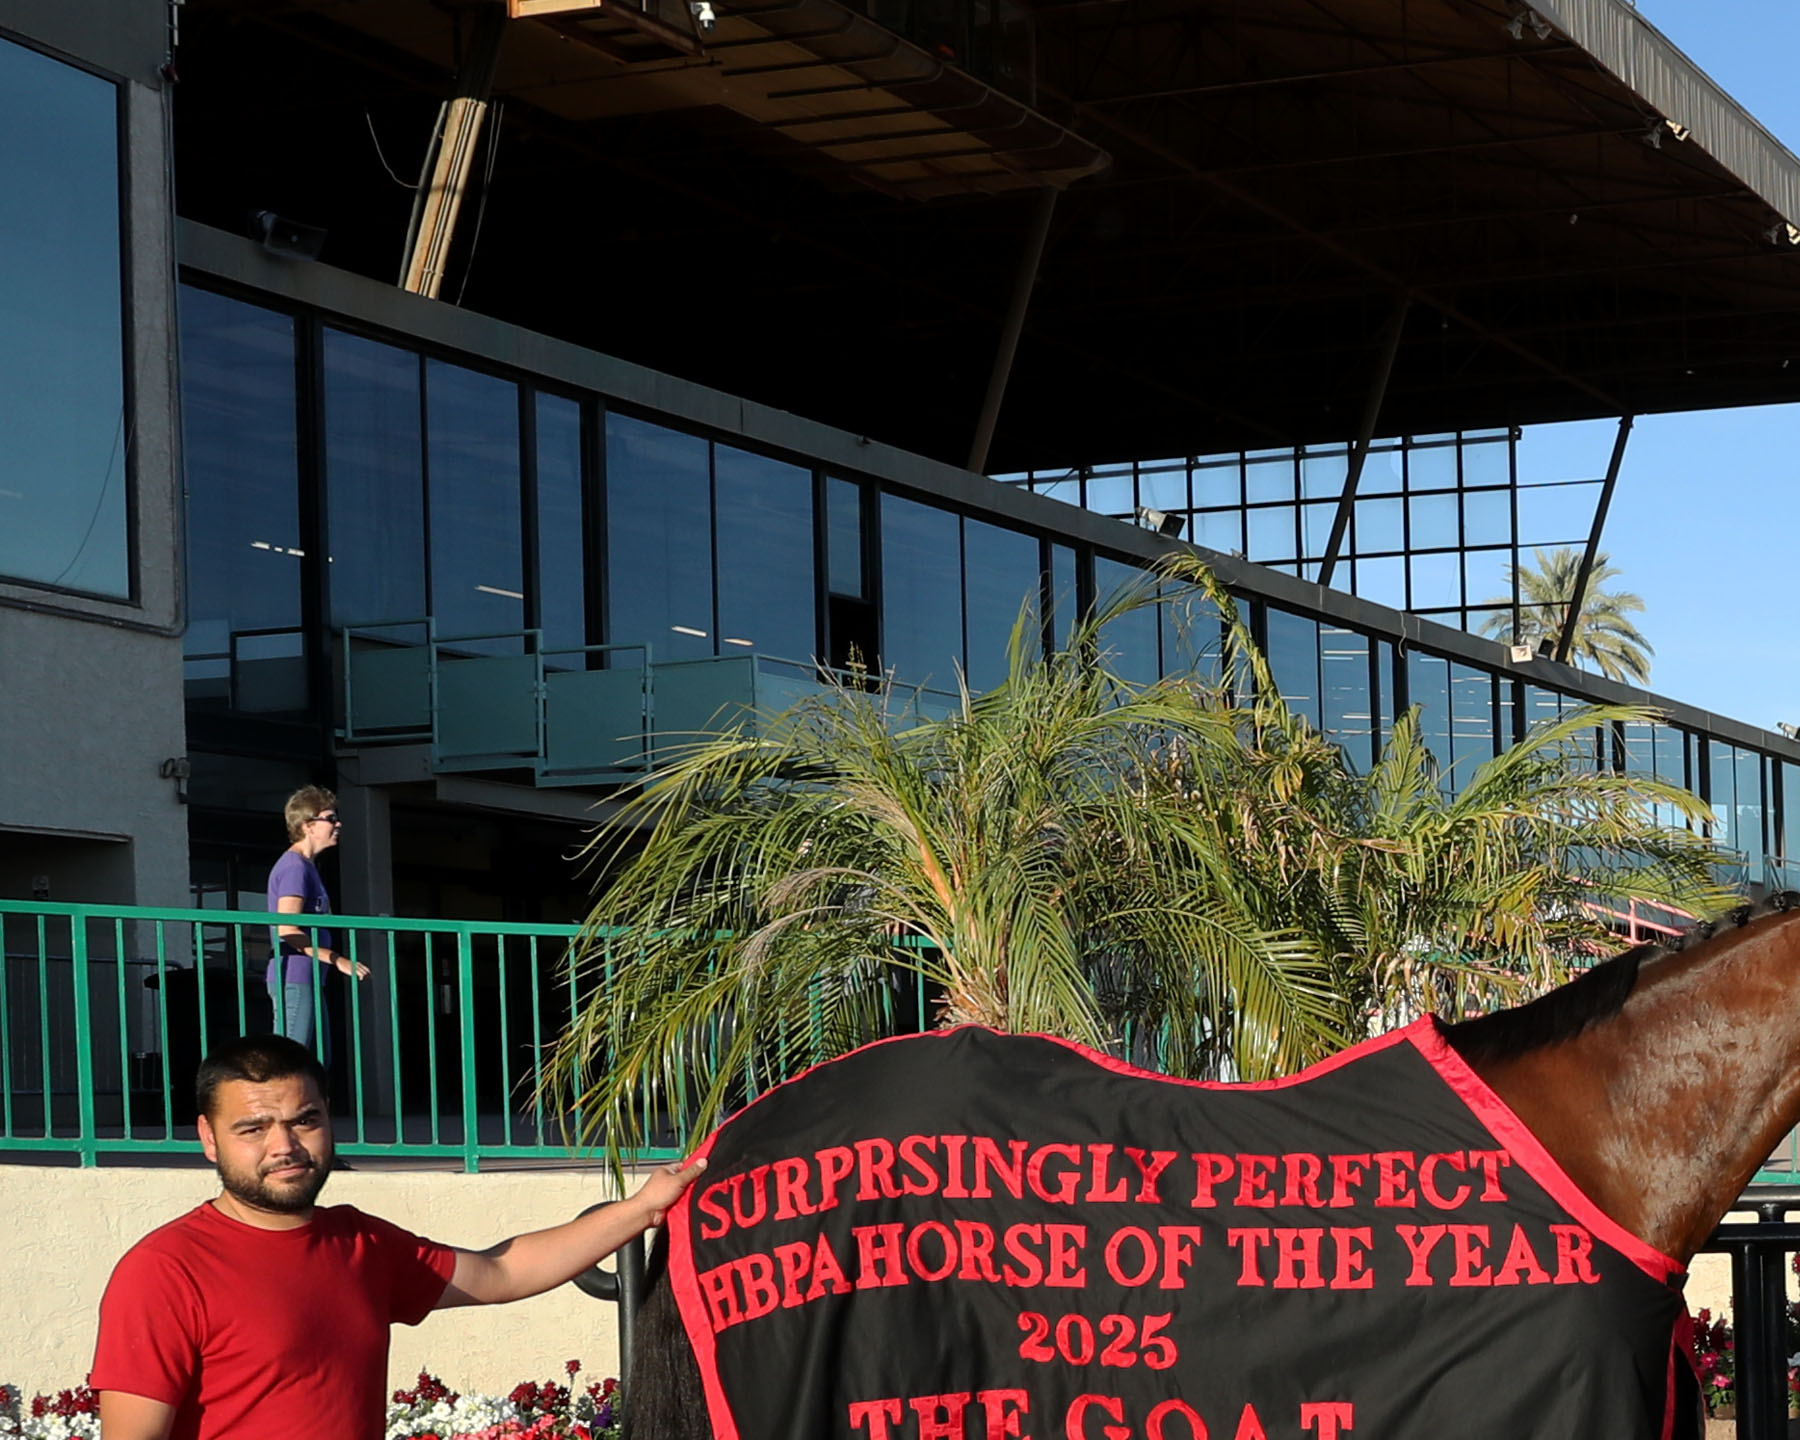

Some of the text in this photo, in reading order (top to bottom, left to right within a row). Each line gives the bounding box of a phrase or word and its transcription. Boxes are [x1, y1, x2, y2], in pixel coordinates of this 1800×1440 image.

[699, 1134, 1513, 1241] SURPRSINGLY PERFECT
[699, 1220, 1601, 1334] HBPA HORSE OF THE YEAR
[1017, 1312, 1179, 1371] 2025
